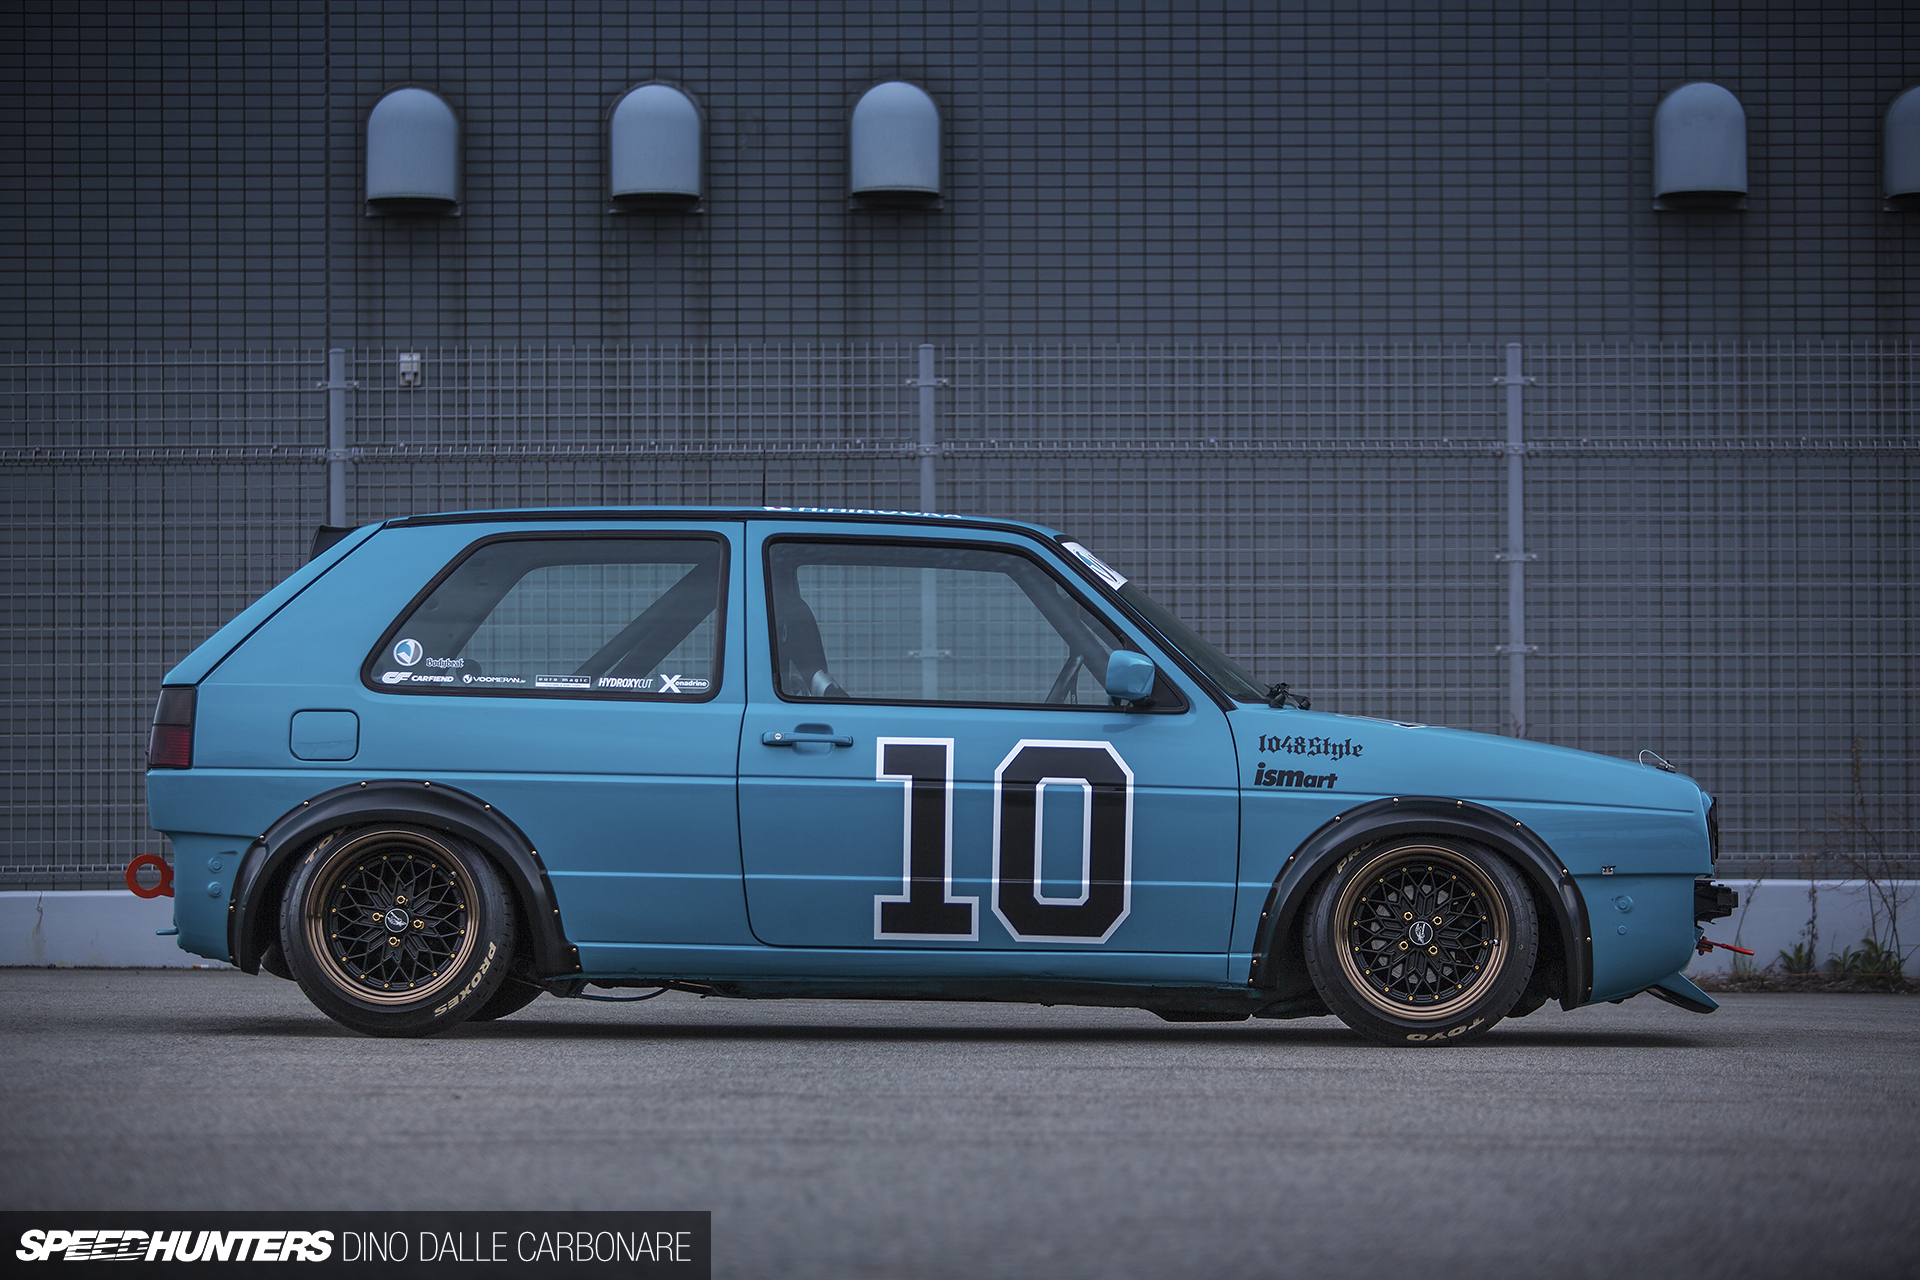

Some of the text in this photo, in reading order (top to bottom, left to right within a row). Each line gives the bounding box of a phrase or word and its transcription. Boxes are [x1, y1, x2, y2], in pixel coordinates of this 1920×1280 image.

[411, 675, 454, 683] CARFIEND
[598, 677, 653, 689] HYDROXYCUT
[658, 674, 709, 693] Xenadrine
[874, 737, 1134, 944] 10
[434, 941, 497, 1017] PROXES
[1406, 1016, 1485, 1041] TOYO
